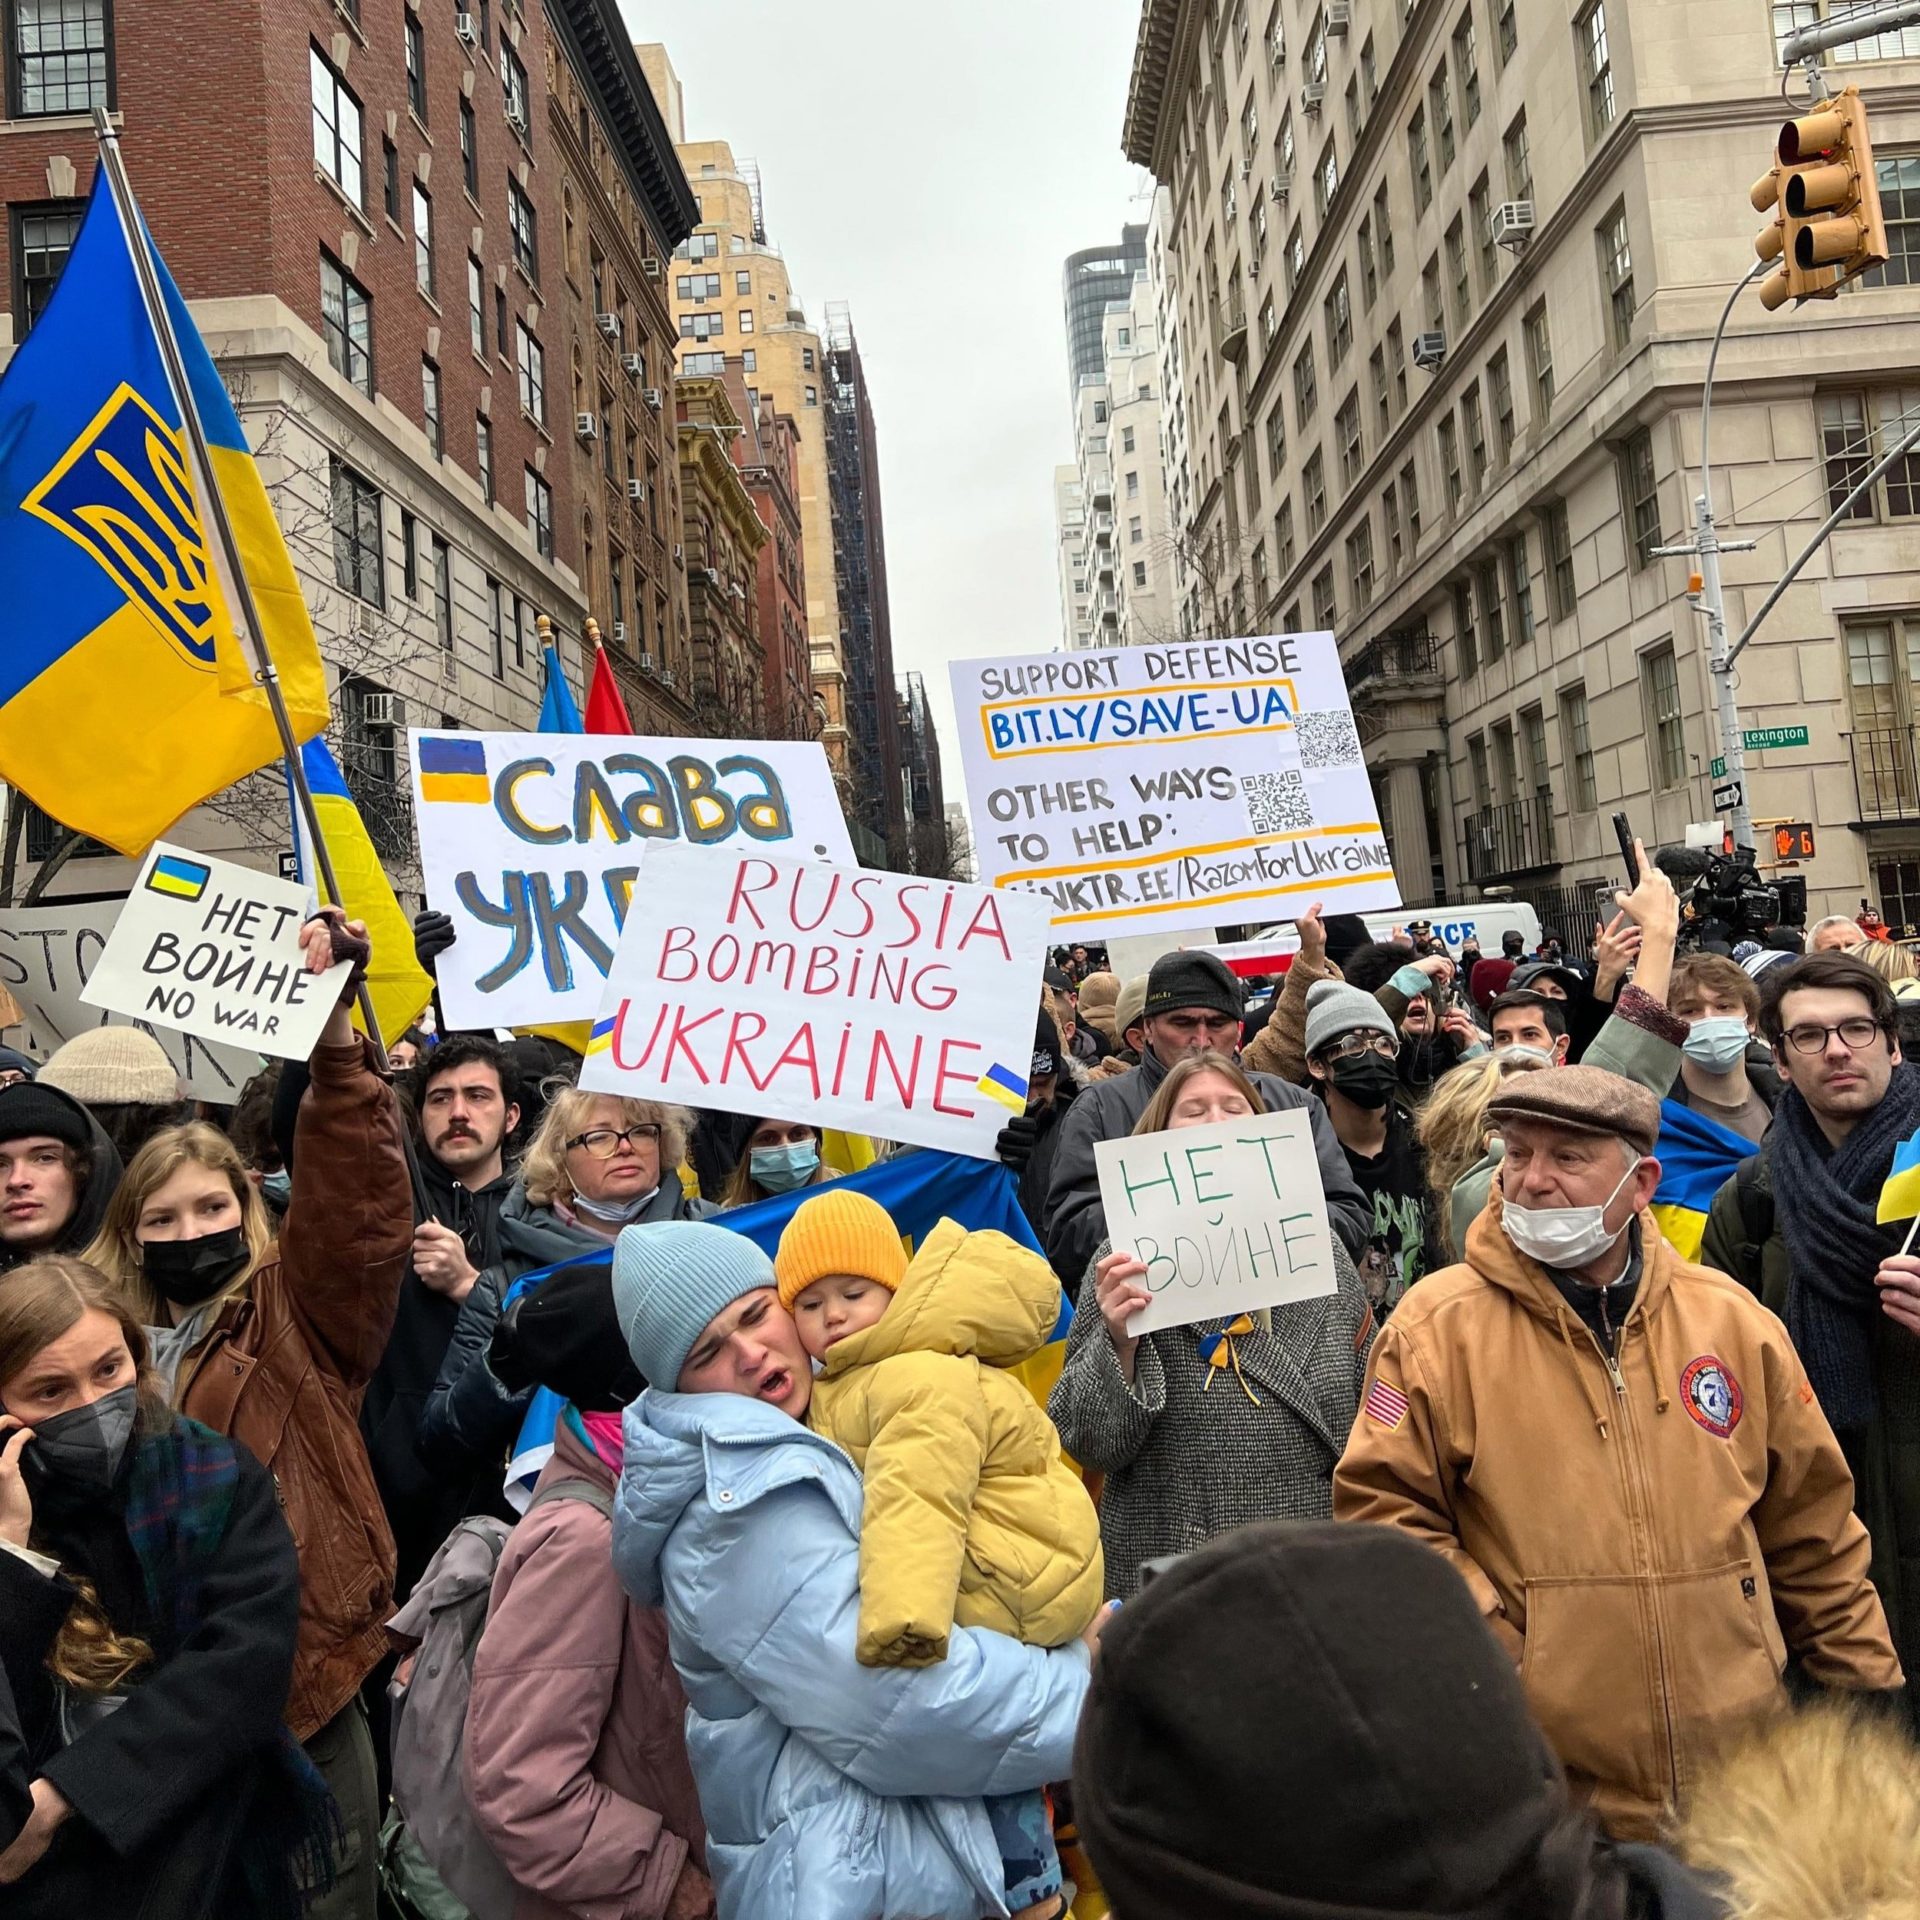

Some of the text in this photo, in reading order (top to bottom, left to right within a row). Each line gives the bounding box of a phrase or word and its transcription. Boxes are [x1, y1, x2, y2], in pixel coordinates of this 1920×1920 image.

[981, 639, 1301, 699] SUPPORT DEFENSE
[991, 686, 1291, 749] BIT.LY/SAVE-UA
[1745, 728, 1804, 743] Lexington
[987, 766, 1237, 821] OTHER WAYS
[998, 813, 1178, 862] TO HELP:
[1802, 832, 1812, 854] 6
[202, 893, 298, 942] НЕТ
[142, 932, 315, 1004] ВОЙНЕ
[145, 985, 280, 1036] NO WAR
[1118, 1135, 1295, 1216] НЕТ
[1134, 1212, 1318, 1293] ВОЙНЕ
